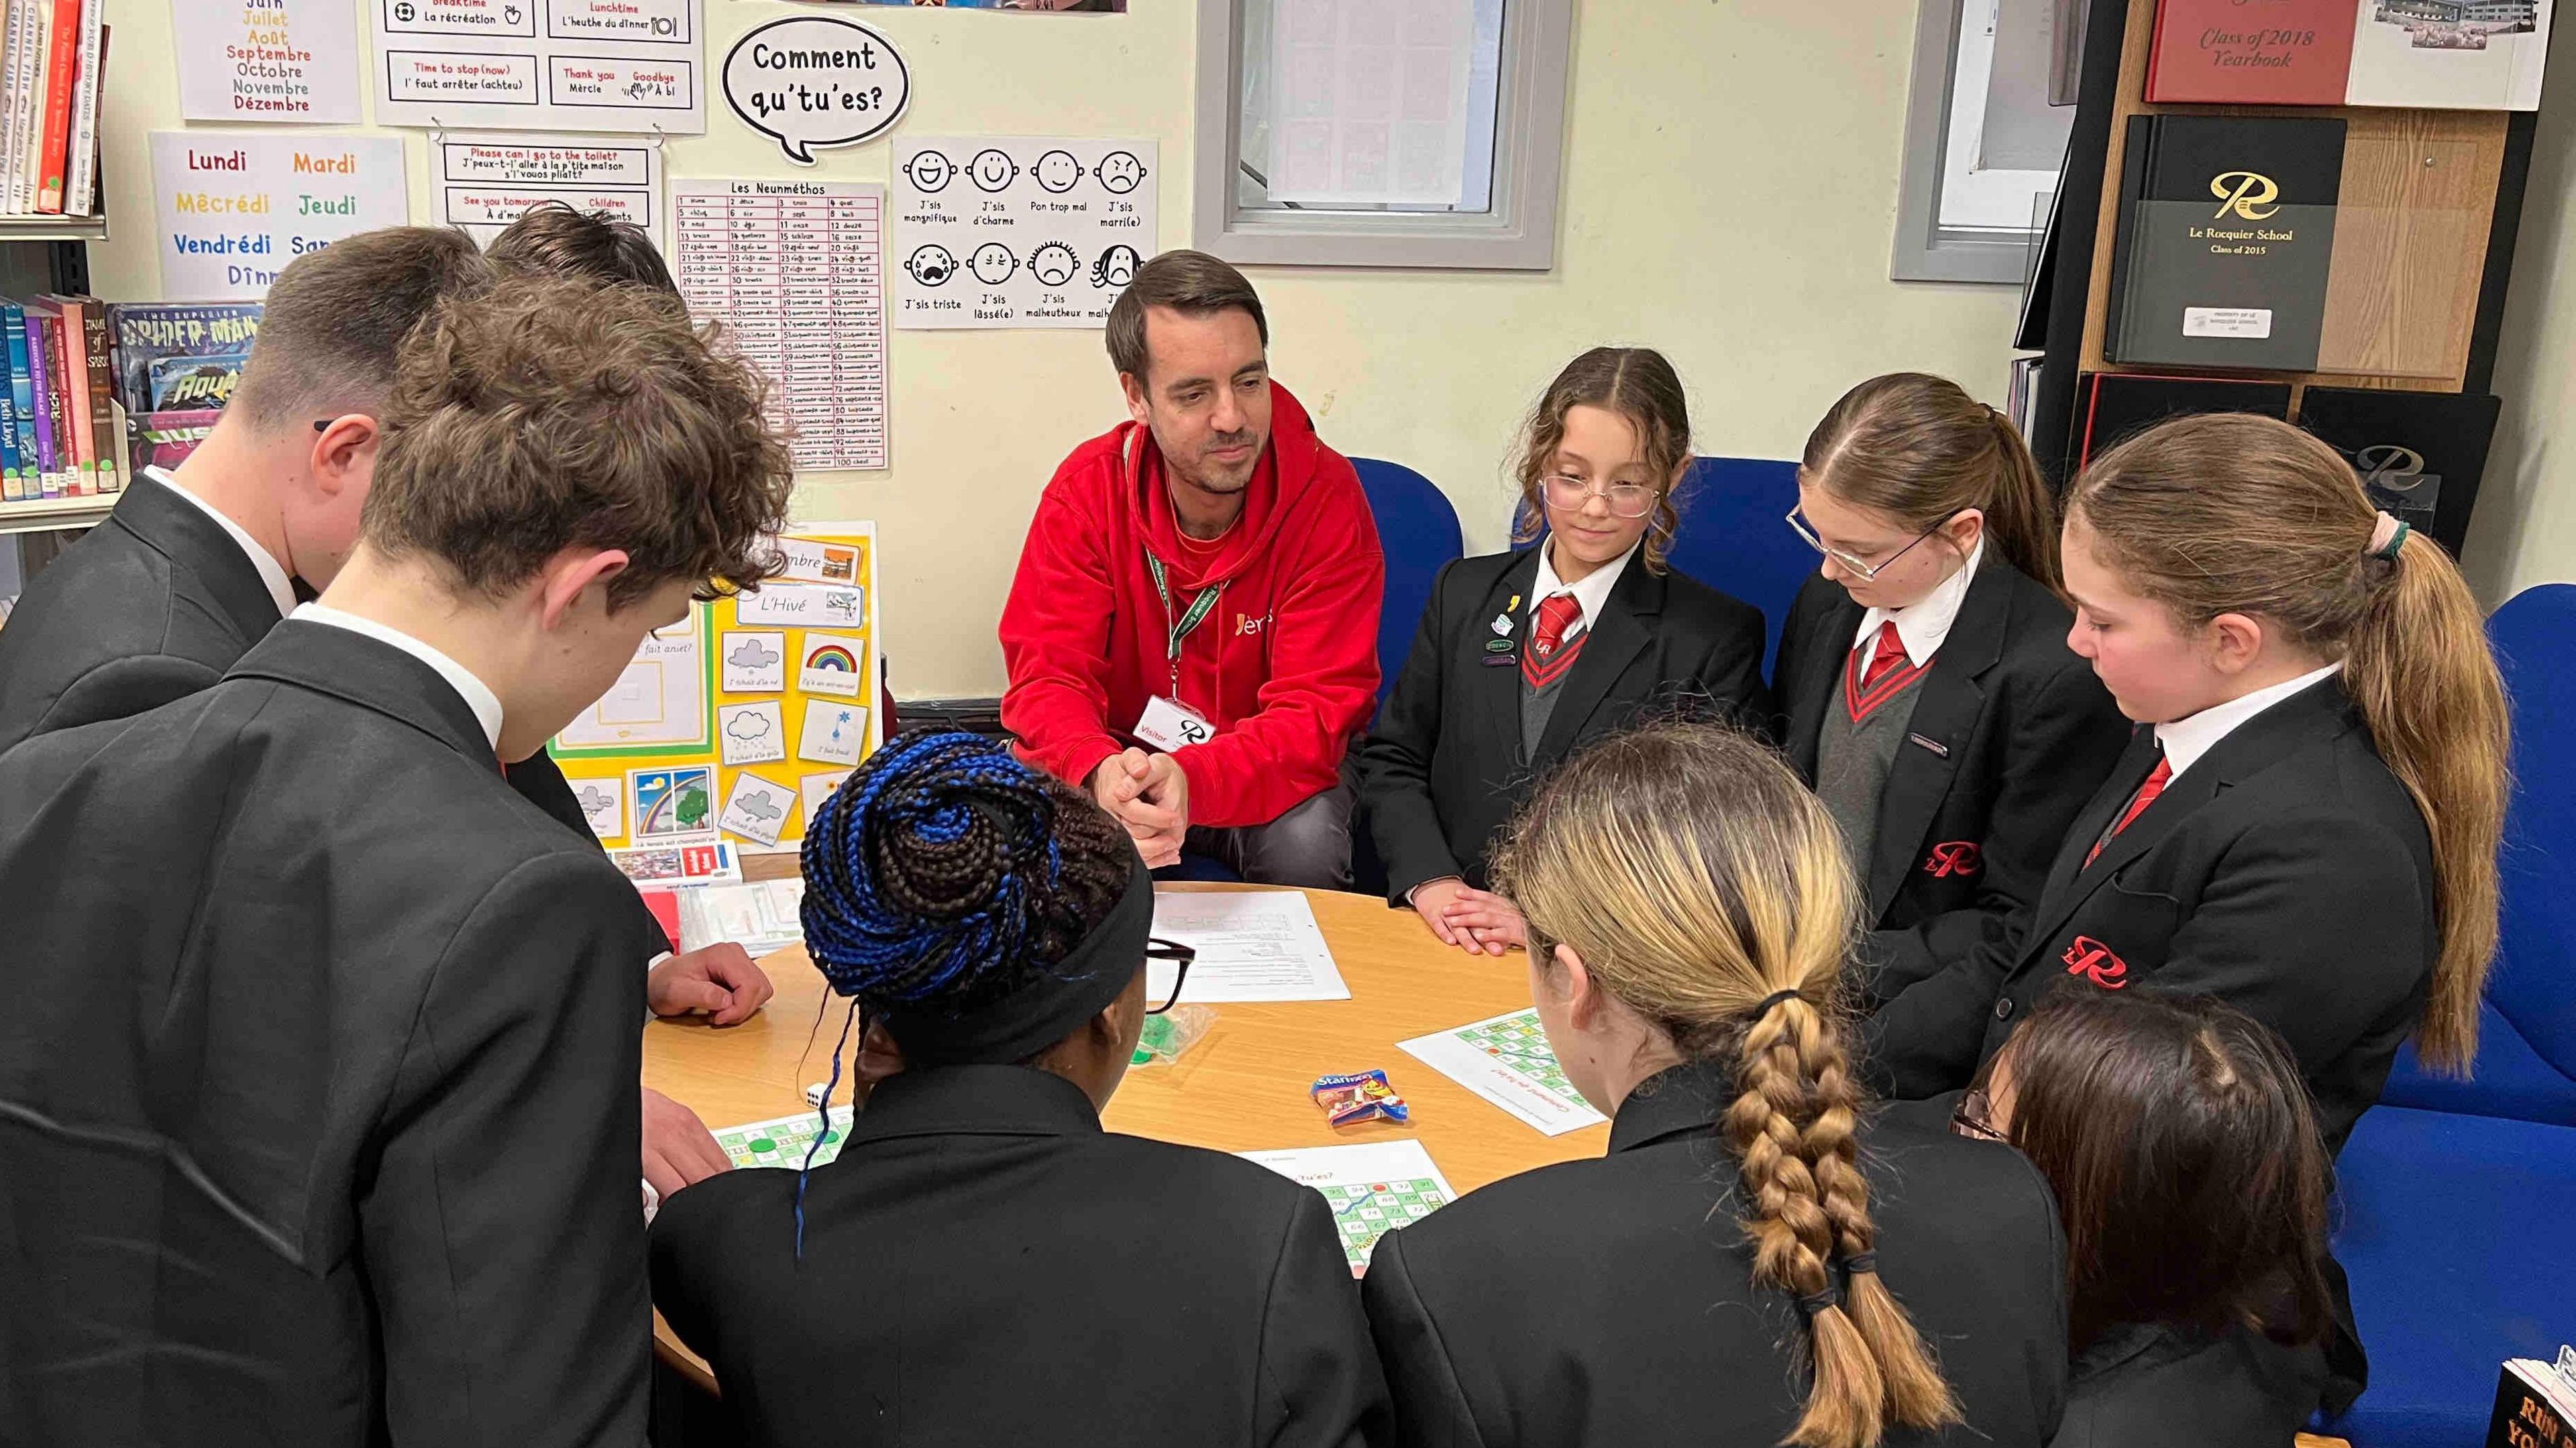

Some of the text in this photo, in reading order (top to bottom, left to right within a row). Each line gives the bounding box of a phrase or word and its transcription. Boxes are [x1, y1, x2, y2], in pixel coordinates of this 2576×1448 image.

[590, 3, 639, 13] Lunchtime
[425, 11, 496, 24] La récréation
[562, 17, 601, 27] L'heuthe
[605, 19, 616, 27] du
[7, 7, 19, 58] CHANNEL
[24, 7, 36, 58] CHANNEL
[248, 30, 288, 46] Août
[2200, 27, 2316, 51] Class of 2018
[227, 45, 311, 64] Septembre
[753, 42, 875, 70] Comment
[2214, 50, 2293, 68] Yearbook
[237, 62, 302, 78] Octobre
[414, 62, 511, 76] Time to stop (now)
[564, 68, 615, 81] Thank you
[5, 64, 15, 89] FISH
[21, 65, 32, 90] FISH
[633, 72, 676, 85] Goodbye
[233, 79, 309, 95] Novembre
[415, 78, 438, 89] faut
[442, 78, 478, 90] arrêter
[481, 78, 523, 91] (achteu)
[655, 84, 661, 96] À
[235, 95, 309, 111] Dézembre
[751, 83, 882, 117] qu'tu'es?
[189, 150, 246, 171] Lundi
[470, 148, 502, 158] Please
[506, 150, 523, 158] can
[533, 152, 545, 161] go
[549, 150, 561, 160] to
[566, 150, 580, 160] the
[585, 151, 617, 161] toilet?
[294, 153, 355, 173] Mardi
[519, 160, 538, 168] aller
[542, 160, 547, 169] à
[551, 161, 559, 169] la
[562, 160, 588, 172] p'tite
[732, 182, 825, 194] Les Neunméthos
[176, 192, 269, 214] Mêcrédi
[299, 194, 356, 215] Jeudi
[464, 197, 479, 205] See
[484, 198, 500, 207] you
[589, 199, 625, 209] Children
[920, 200, 941, 210] J'sis
[982, 201, 1006, 211] J'sis
[1030, 202, 1087, 213] Pon trop mal
[1108, 202, 1133, 212] J'sis
[487, 209, 494, 219] À
[904, 213, 958, 224] mangnifique
[973, 215, 1014, 226] d'charme
[1100, 215, 1140, 227] marri(e)
[832, 233, 839, 241] 16
[2190, 227, 2293, 241] Le Rocquier School
[174, 233, 270, 254] Vendrédi
[2210, 245, 2266, 255] Class of 2015
[732, 276, 742, 284] 30
[906, 299, 962, 309] J'sis triste
[982, 294, 1006, 304] J'sis
[1042, 294, 1065, 304] J'sis
[144, 312, 166, 321] THE
[974, 308, 1014, 319] lâssé(e)
[1026, 308, 1081, 319] malheutheux
[833, 353, 843, 361] 60
[1, 398, 13, 420] Beth
[1, 421, 16, 449] Lloyd
[761, 596, 807, 612] L'Hivé
[645, 644, 661, 655] fait
[1140, 724, 1168, 743] Visitor
